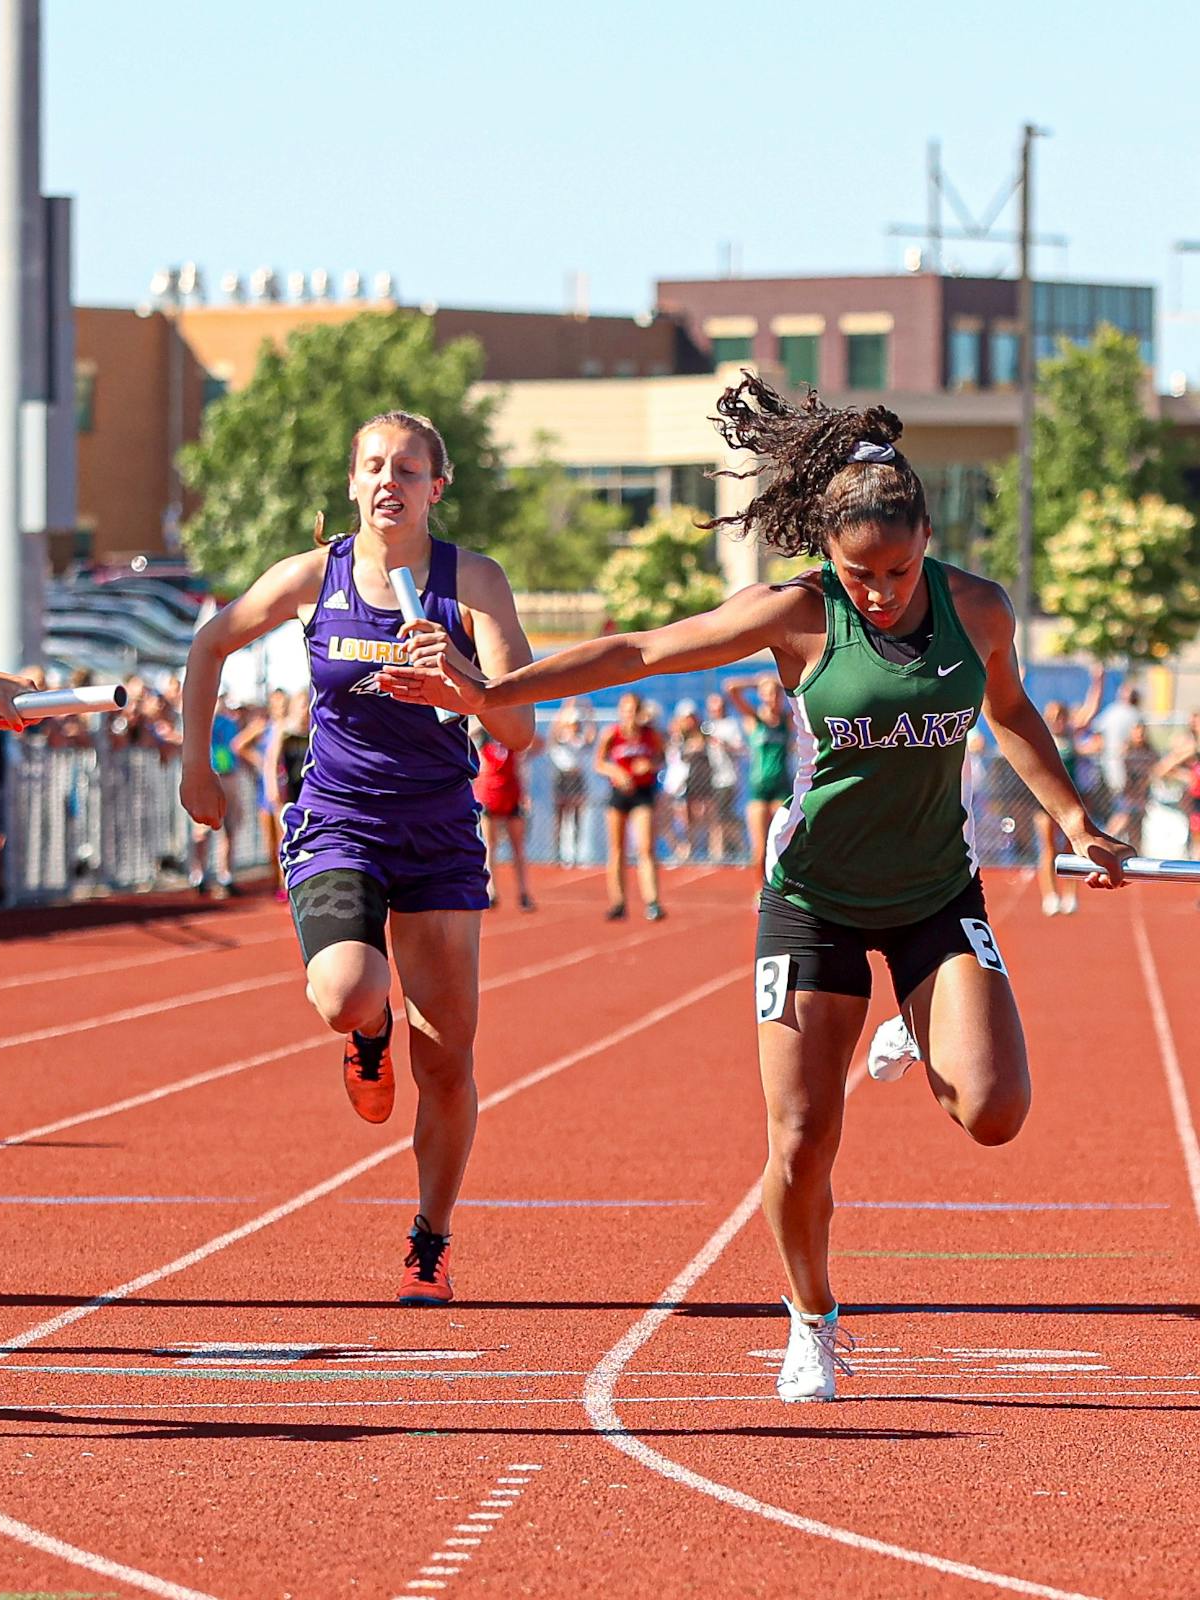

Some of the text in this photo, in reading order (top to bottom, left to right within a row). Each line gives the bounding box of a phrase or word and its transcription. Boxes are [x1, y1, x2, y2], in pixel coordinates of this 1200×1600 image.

[328, 636, 414, 665] LOURD
[823, 707, 975, 750] BLAKE
[972, 922, 1002, 969] 3
[761, 961, 780, 1018] 3
